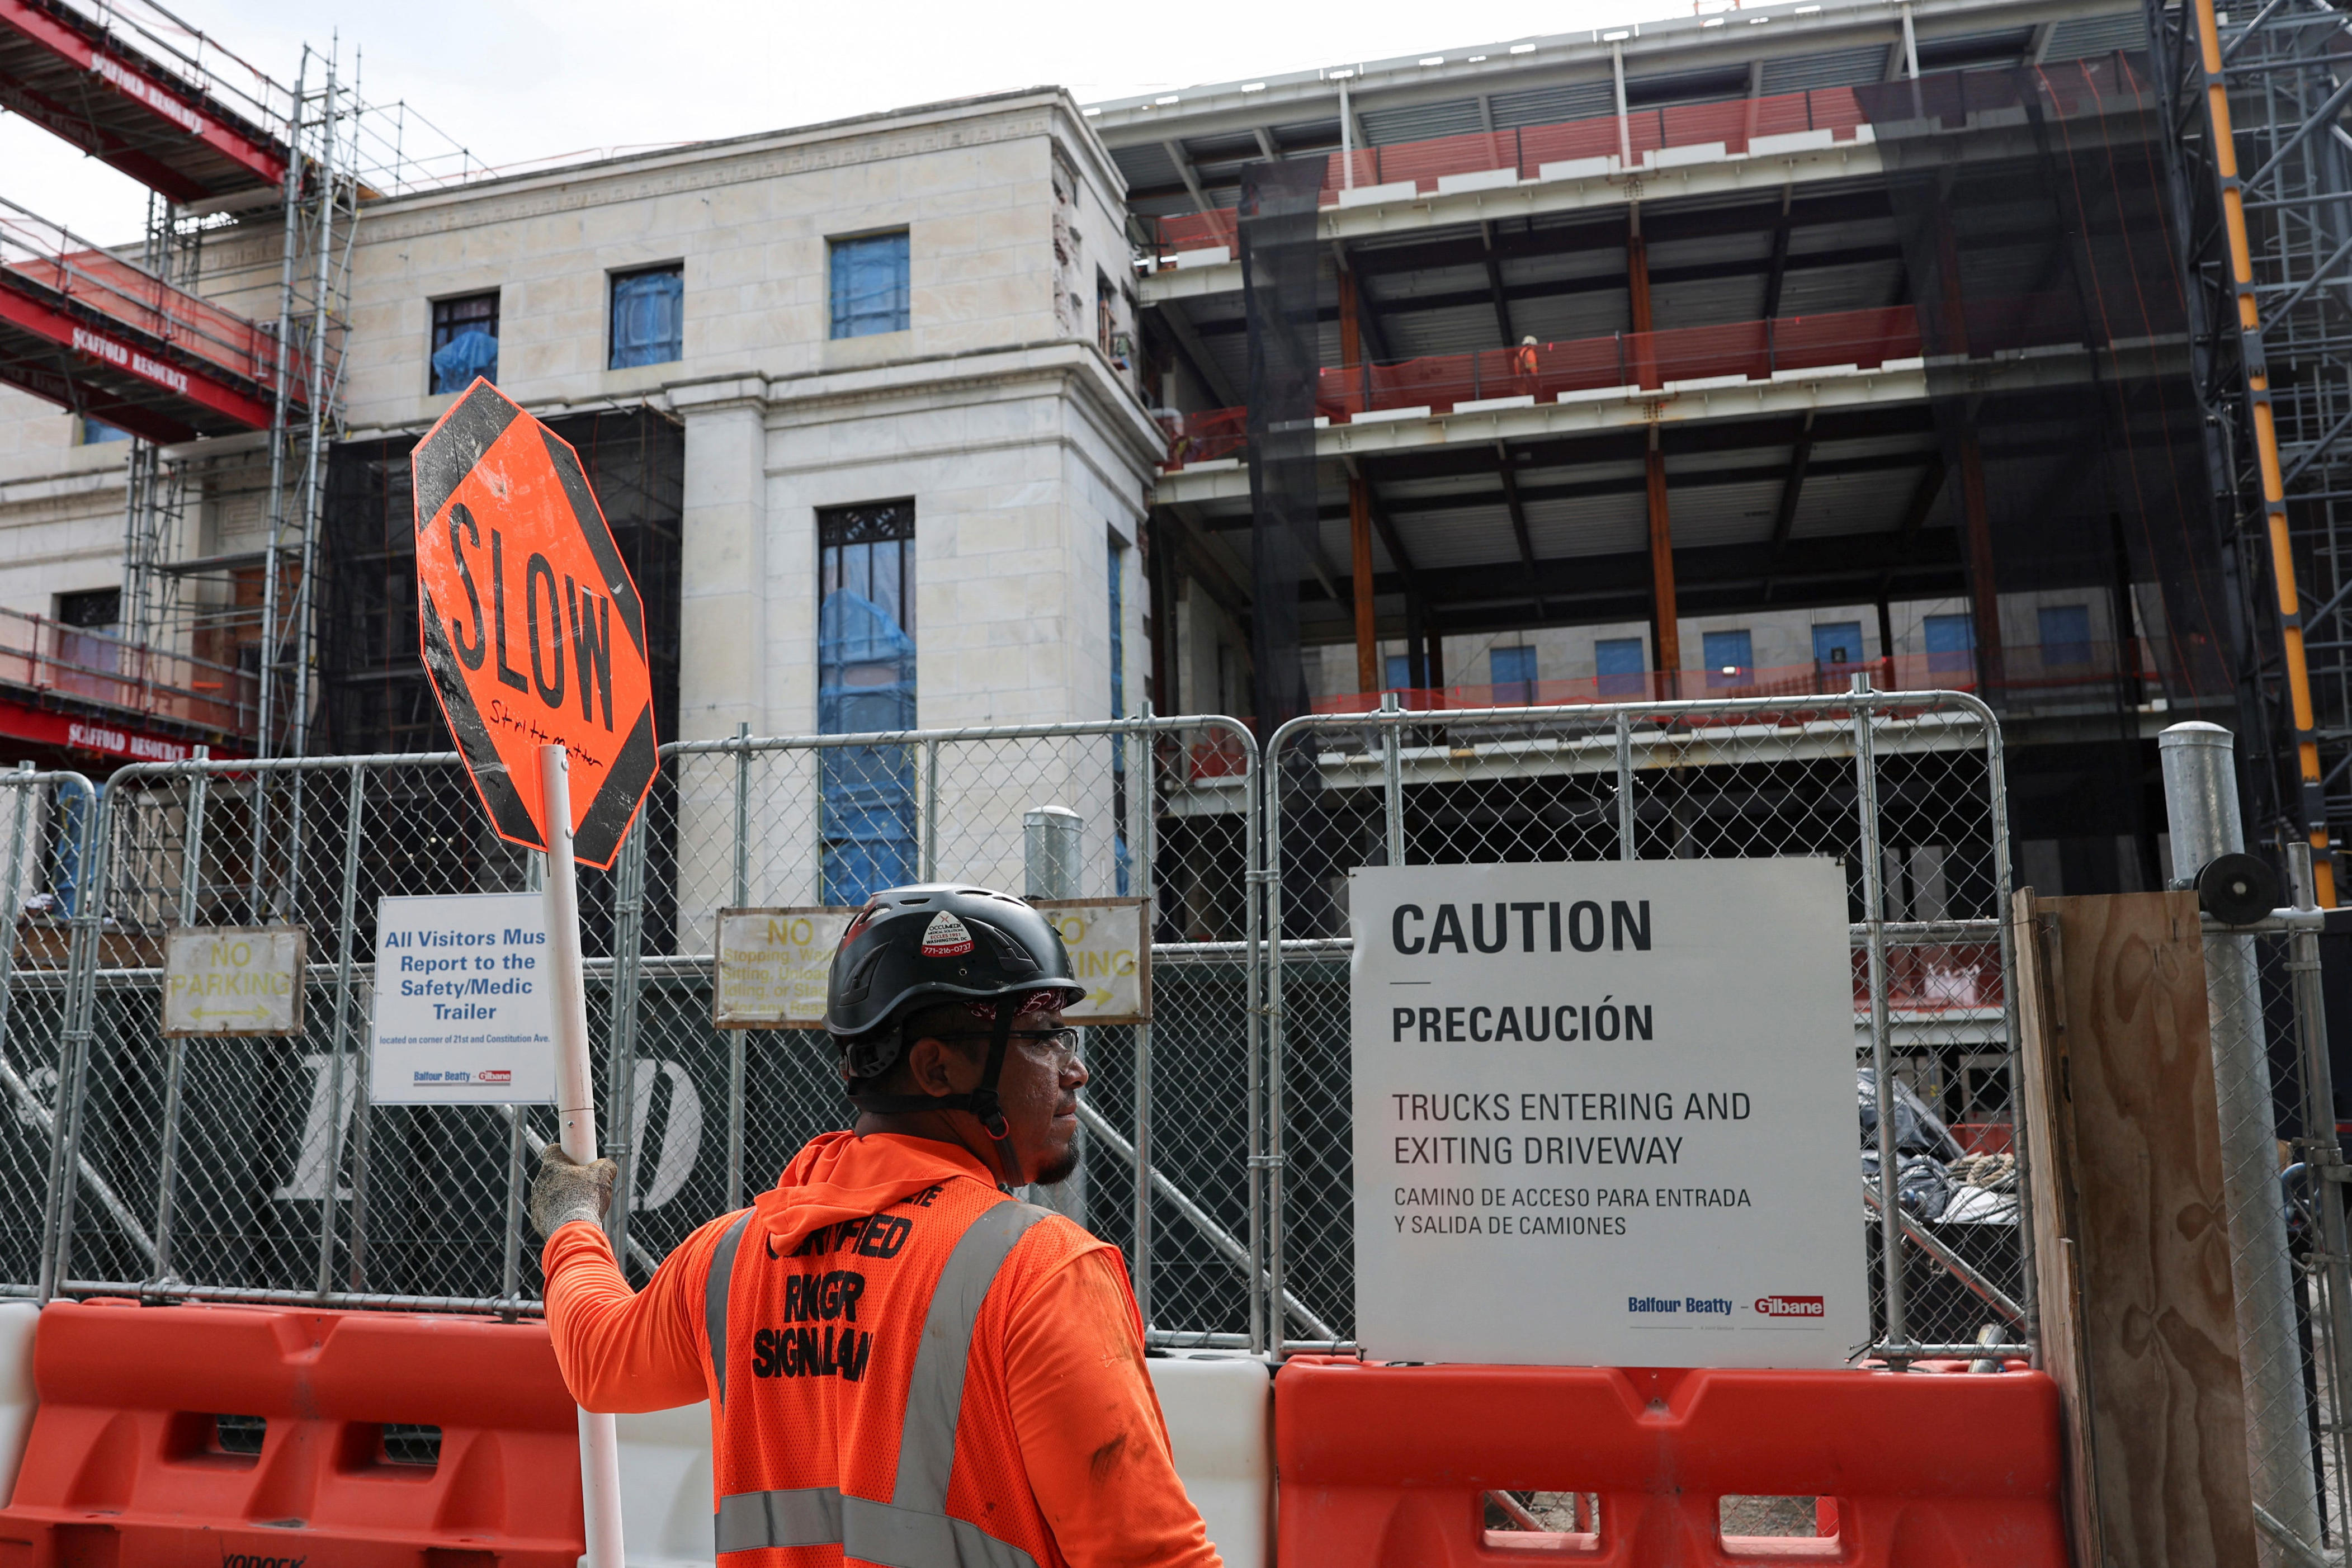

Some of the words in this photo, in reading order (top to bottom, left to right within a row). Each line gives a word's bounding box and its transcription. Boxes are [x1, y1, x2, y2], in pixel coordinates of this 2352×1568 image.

[449, 503, 613, 733] SLOW
[768, 919, 814, 946] NO
[1049, 917, 1085, 945] O
[1392, 900, 1651, 955] CAUTION
[385, 932, 412, 948] All
[418, 931, 496, 947] Visitors
[924, 943, 971, 954] 771-216-0737
[210, 942, 251, 967] NO
[401, 955, 467, 975] Report
[474, 956, 494, 970] to
[503, 953, 535, 969] the
[172, 972, 290, 998] PARKING
[401, 978, 533, 999] Safety/Medic
[774, 986, 790, 997] or
[433, 1003, 497, 1019] Trailer
[1393, 995, 1653, 1042] PRECAUCIÓN
[380, 1036, 407, 1044] located
[445, 1035, 452, 1043] of
[454, 1035, 469, 1043] 21st
[470, 1035, 484, 1043] and
[486, 1034, 532, 1043] Constitution
[533, 1034, 551, 1042] Ave.
[414, 1071, 442, 1081] Balfour
[445, 1071, 470, 1082] Beatty
[1392, 1094, 1510, 1121] TRUCKS
[1521, 1093, 1673, 1120] ENTERING
[1684, 1092, 1751, 1120] AND
[1395, 1136, 1512, 1164] EXITING
[1525, 1137, 1683, 1164] DRIVEWAY
[1395, 1188, 1474, 1206] CAMINO
[1482, 1189, 1505, 1206] DE
[1512, 1188, 1589, 1207] ACCESO
[1597, 1189, 1649, 1207] PARA
[1656, 1189, 1751, 1207] ENTRADA
[1394, 1216, 1405, 1233] Y
[1411, 1216, 1482, 1234] SALIDA
[1489, 1216, 1513, 1234] DE
[1519, 1217, 1626, 1235] CAMIONES
[1628, 1297, 1681, 1312] Balfour
[1686, 1298, 1732, 1315] Beatty
[1755, 1297, 1824, 1316] Gilbane
